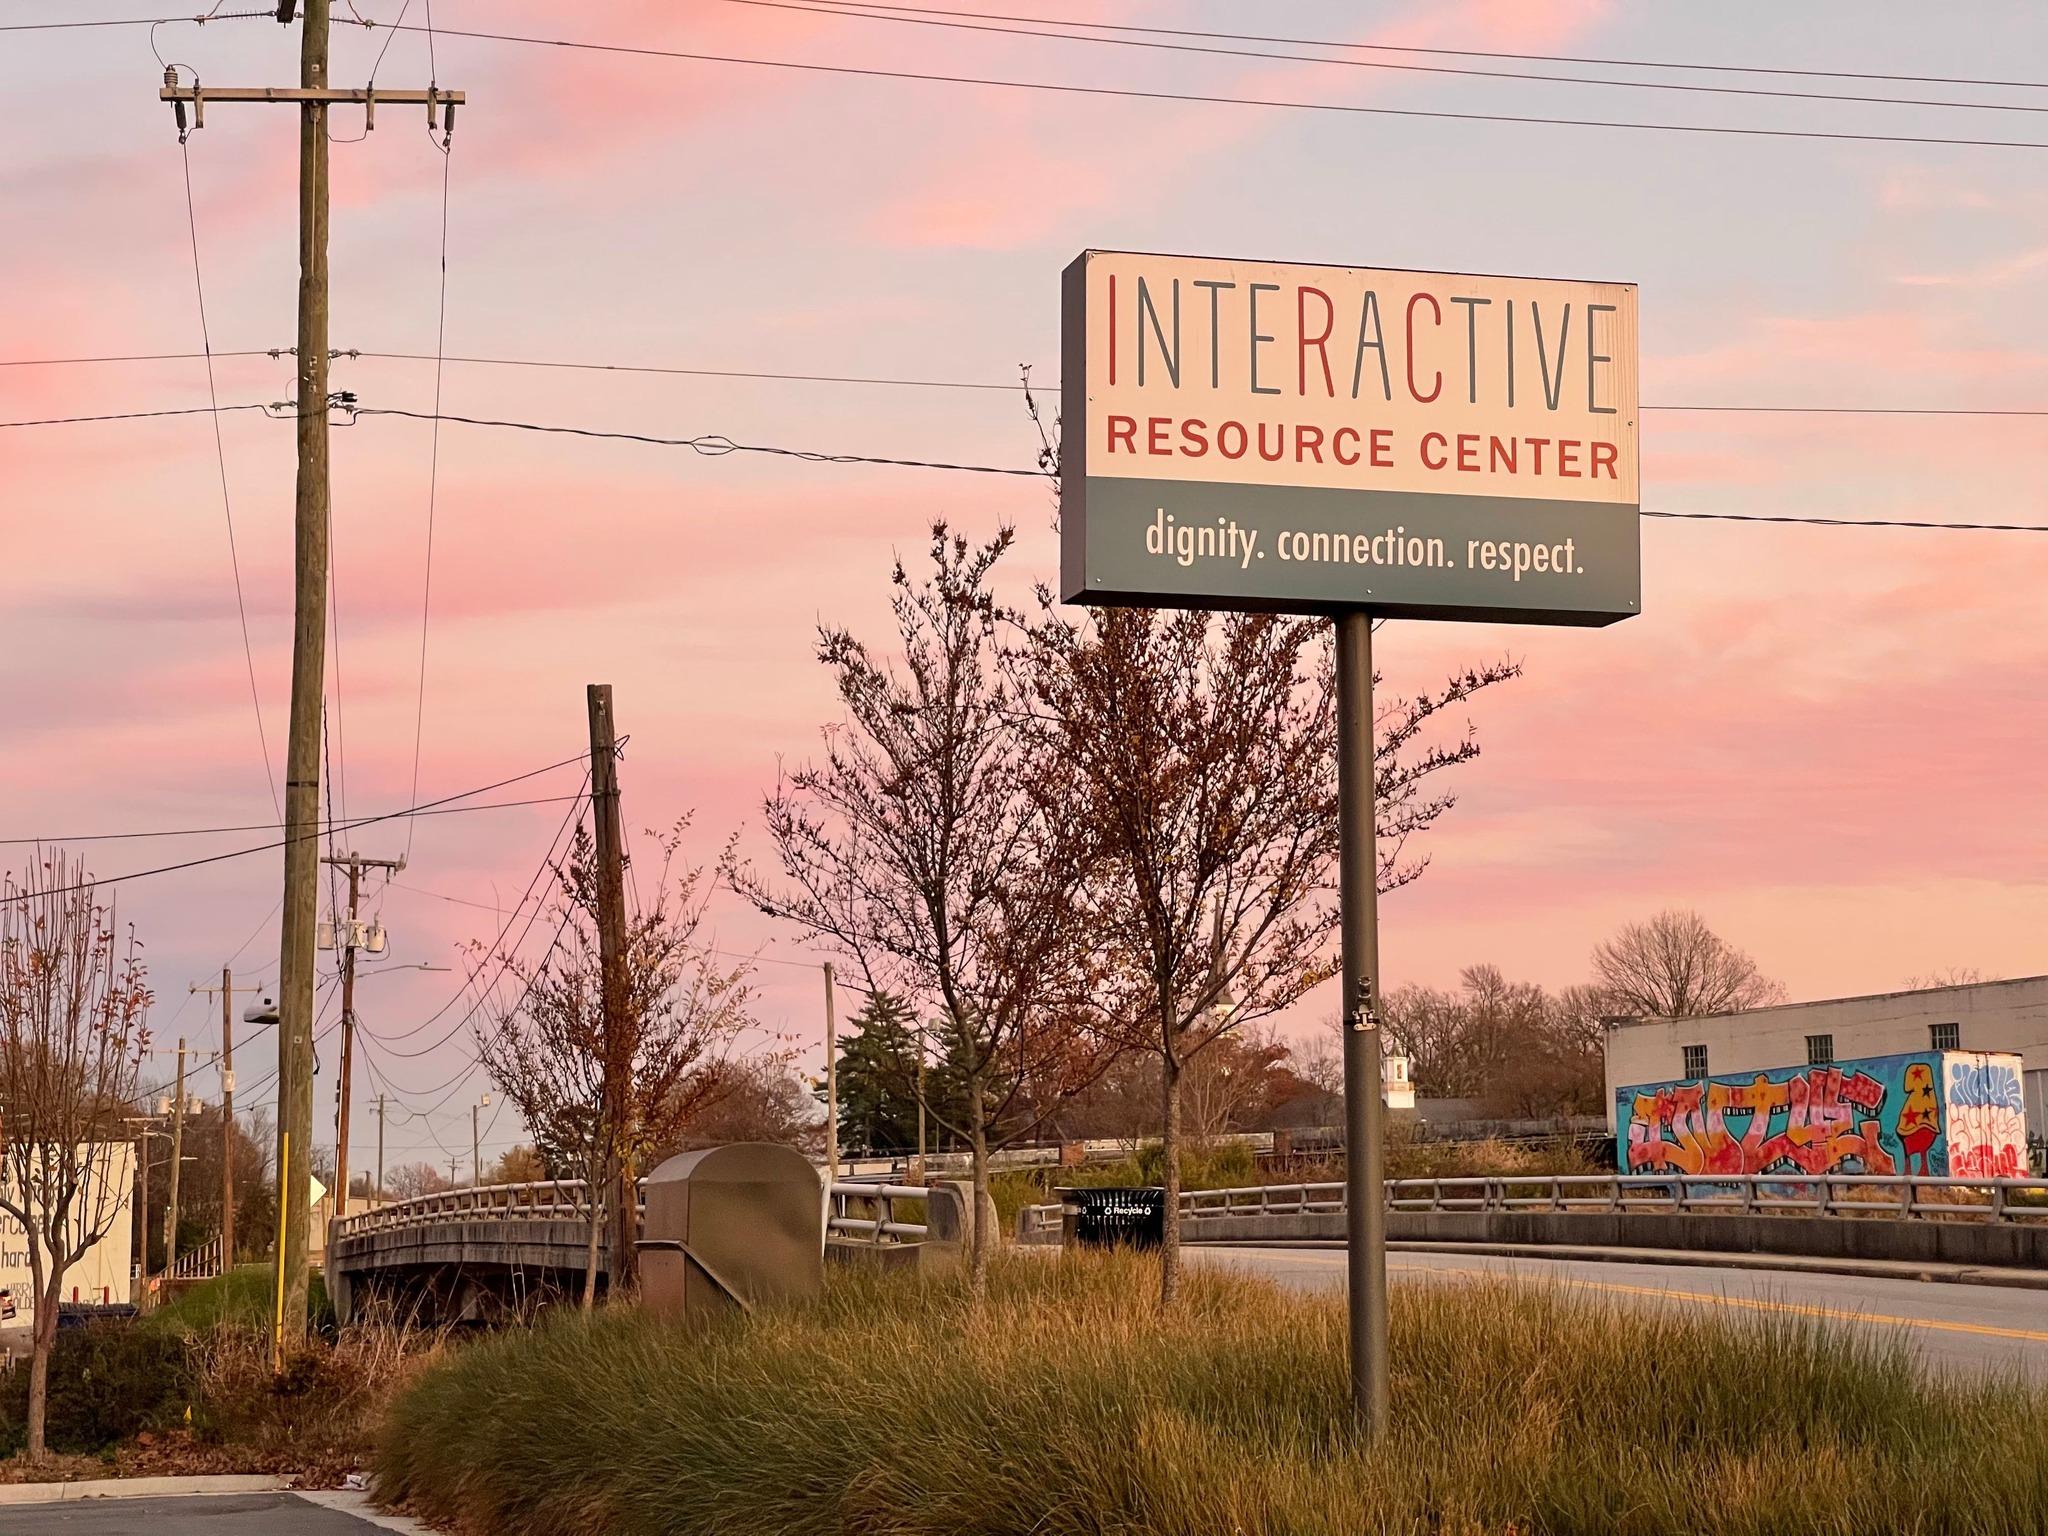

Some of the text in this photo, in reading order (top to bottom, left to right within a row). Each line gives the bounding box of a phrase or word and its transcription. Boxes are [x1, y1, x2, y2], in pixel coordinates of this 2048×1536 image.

[1108, 274, 1618, 415] INTERACTIVE
[1107, 415, 1618, 479] RESOURCE CENTER
[1145, 508, 1584, 581] dignity. connection. respect.
[1113, 1206, 1143, 1216] Recycle
